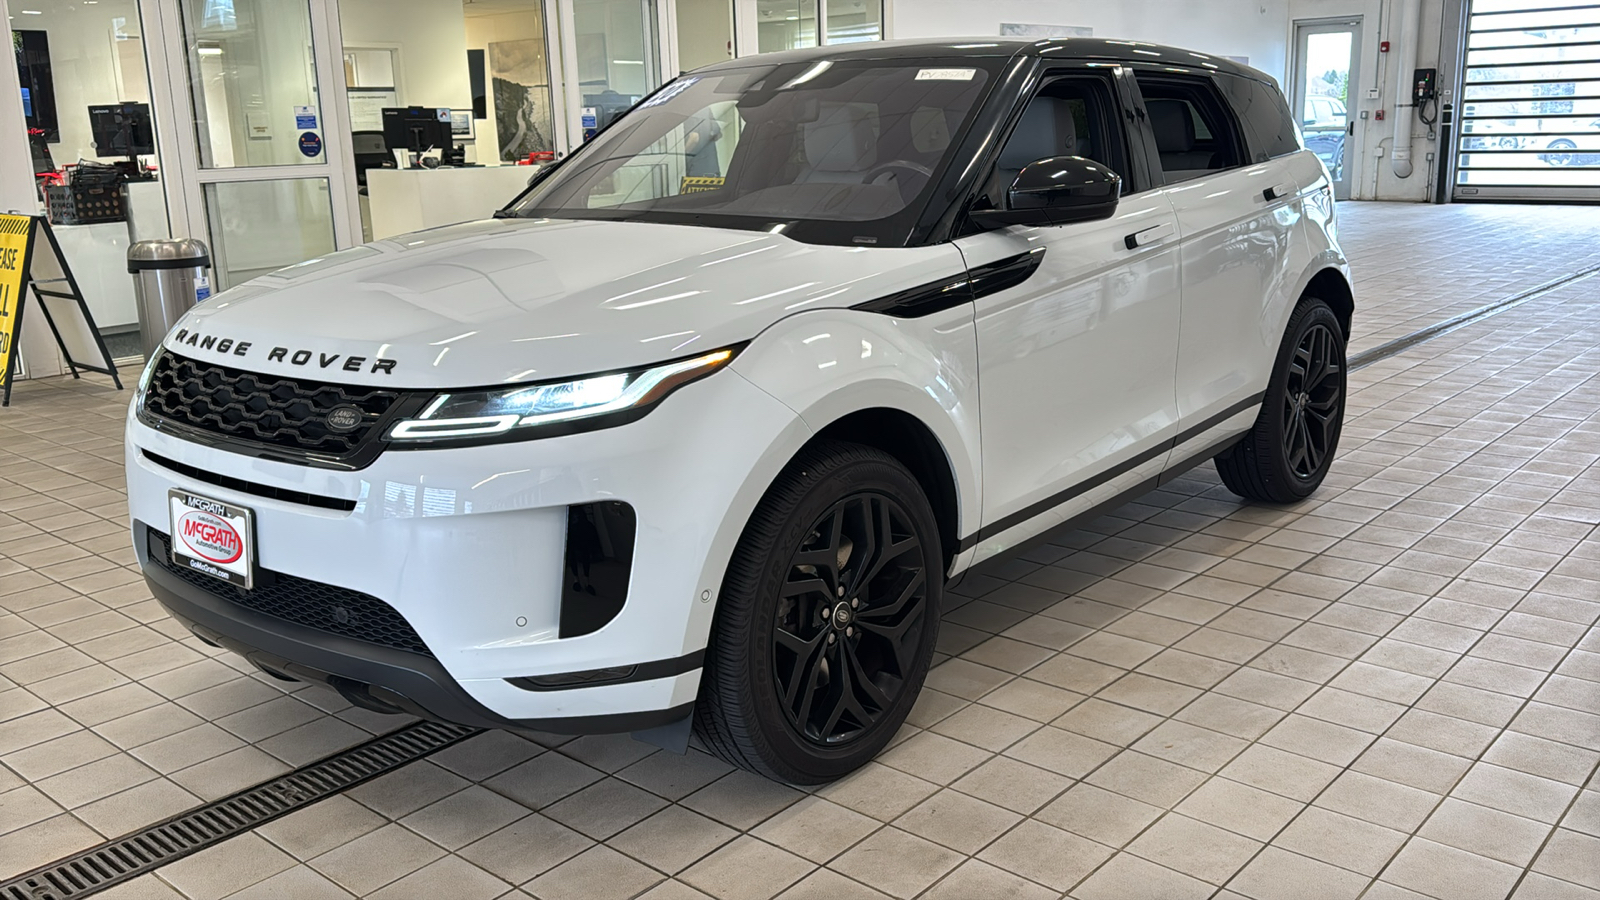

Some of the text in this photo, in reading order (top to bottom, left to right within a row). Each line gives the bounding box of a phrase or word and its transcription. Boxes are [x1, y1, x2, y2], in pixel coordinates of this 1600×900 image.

[175, 328, 397, 375] RANGE ROVER
[333, 416, 354, 425] ROVER
[196, 538, 232, 556] Automotive Group
[190, 560, 229, 579] GoMcGrath.com
